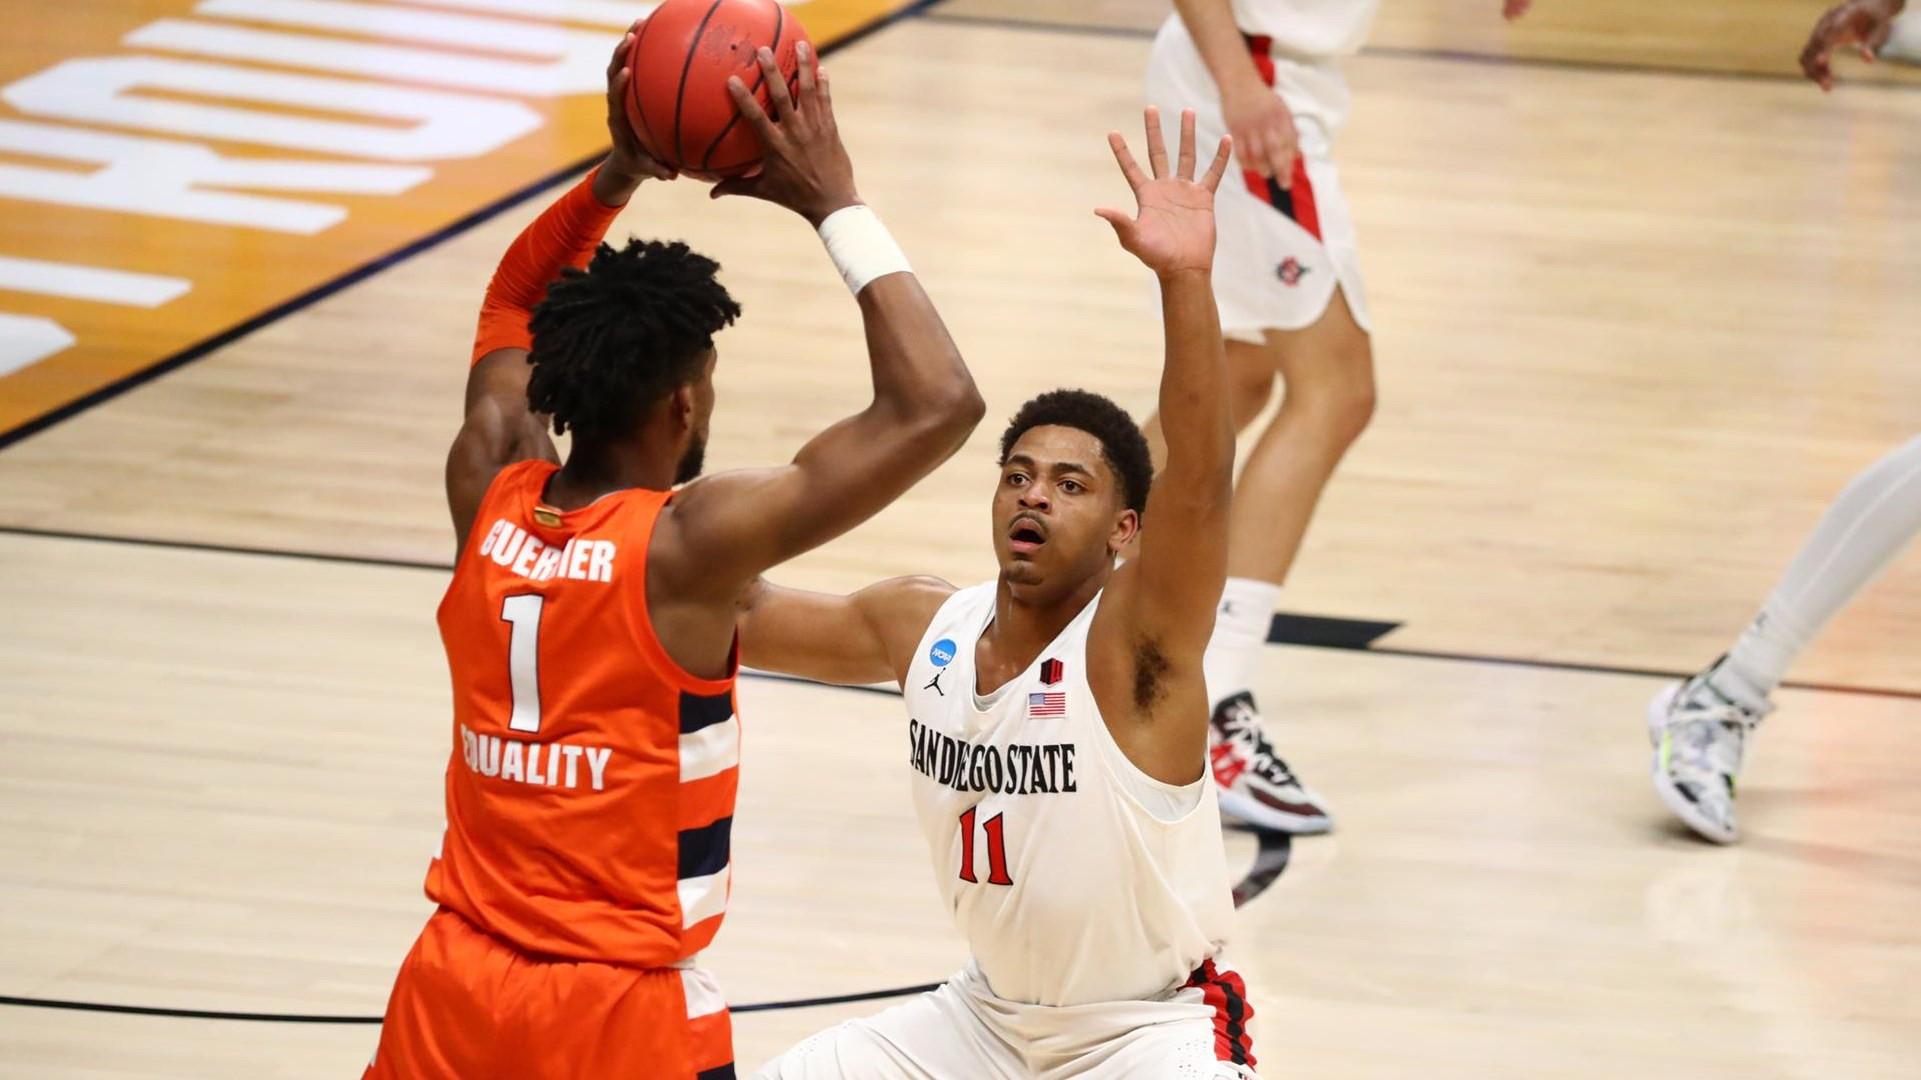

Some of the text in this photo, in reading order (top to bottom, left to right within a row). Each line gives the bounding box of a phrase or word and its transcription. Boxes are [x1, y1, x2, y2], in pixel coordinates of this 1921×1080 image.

[501, 593, 545, 733] 1
[909, 718, 1077, 794] SAN DIEGO STATE
[959, 804, 1014, 886] 11
